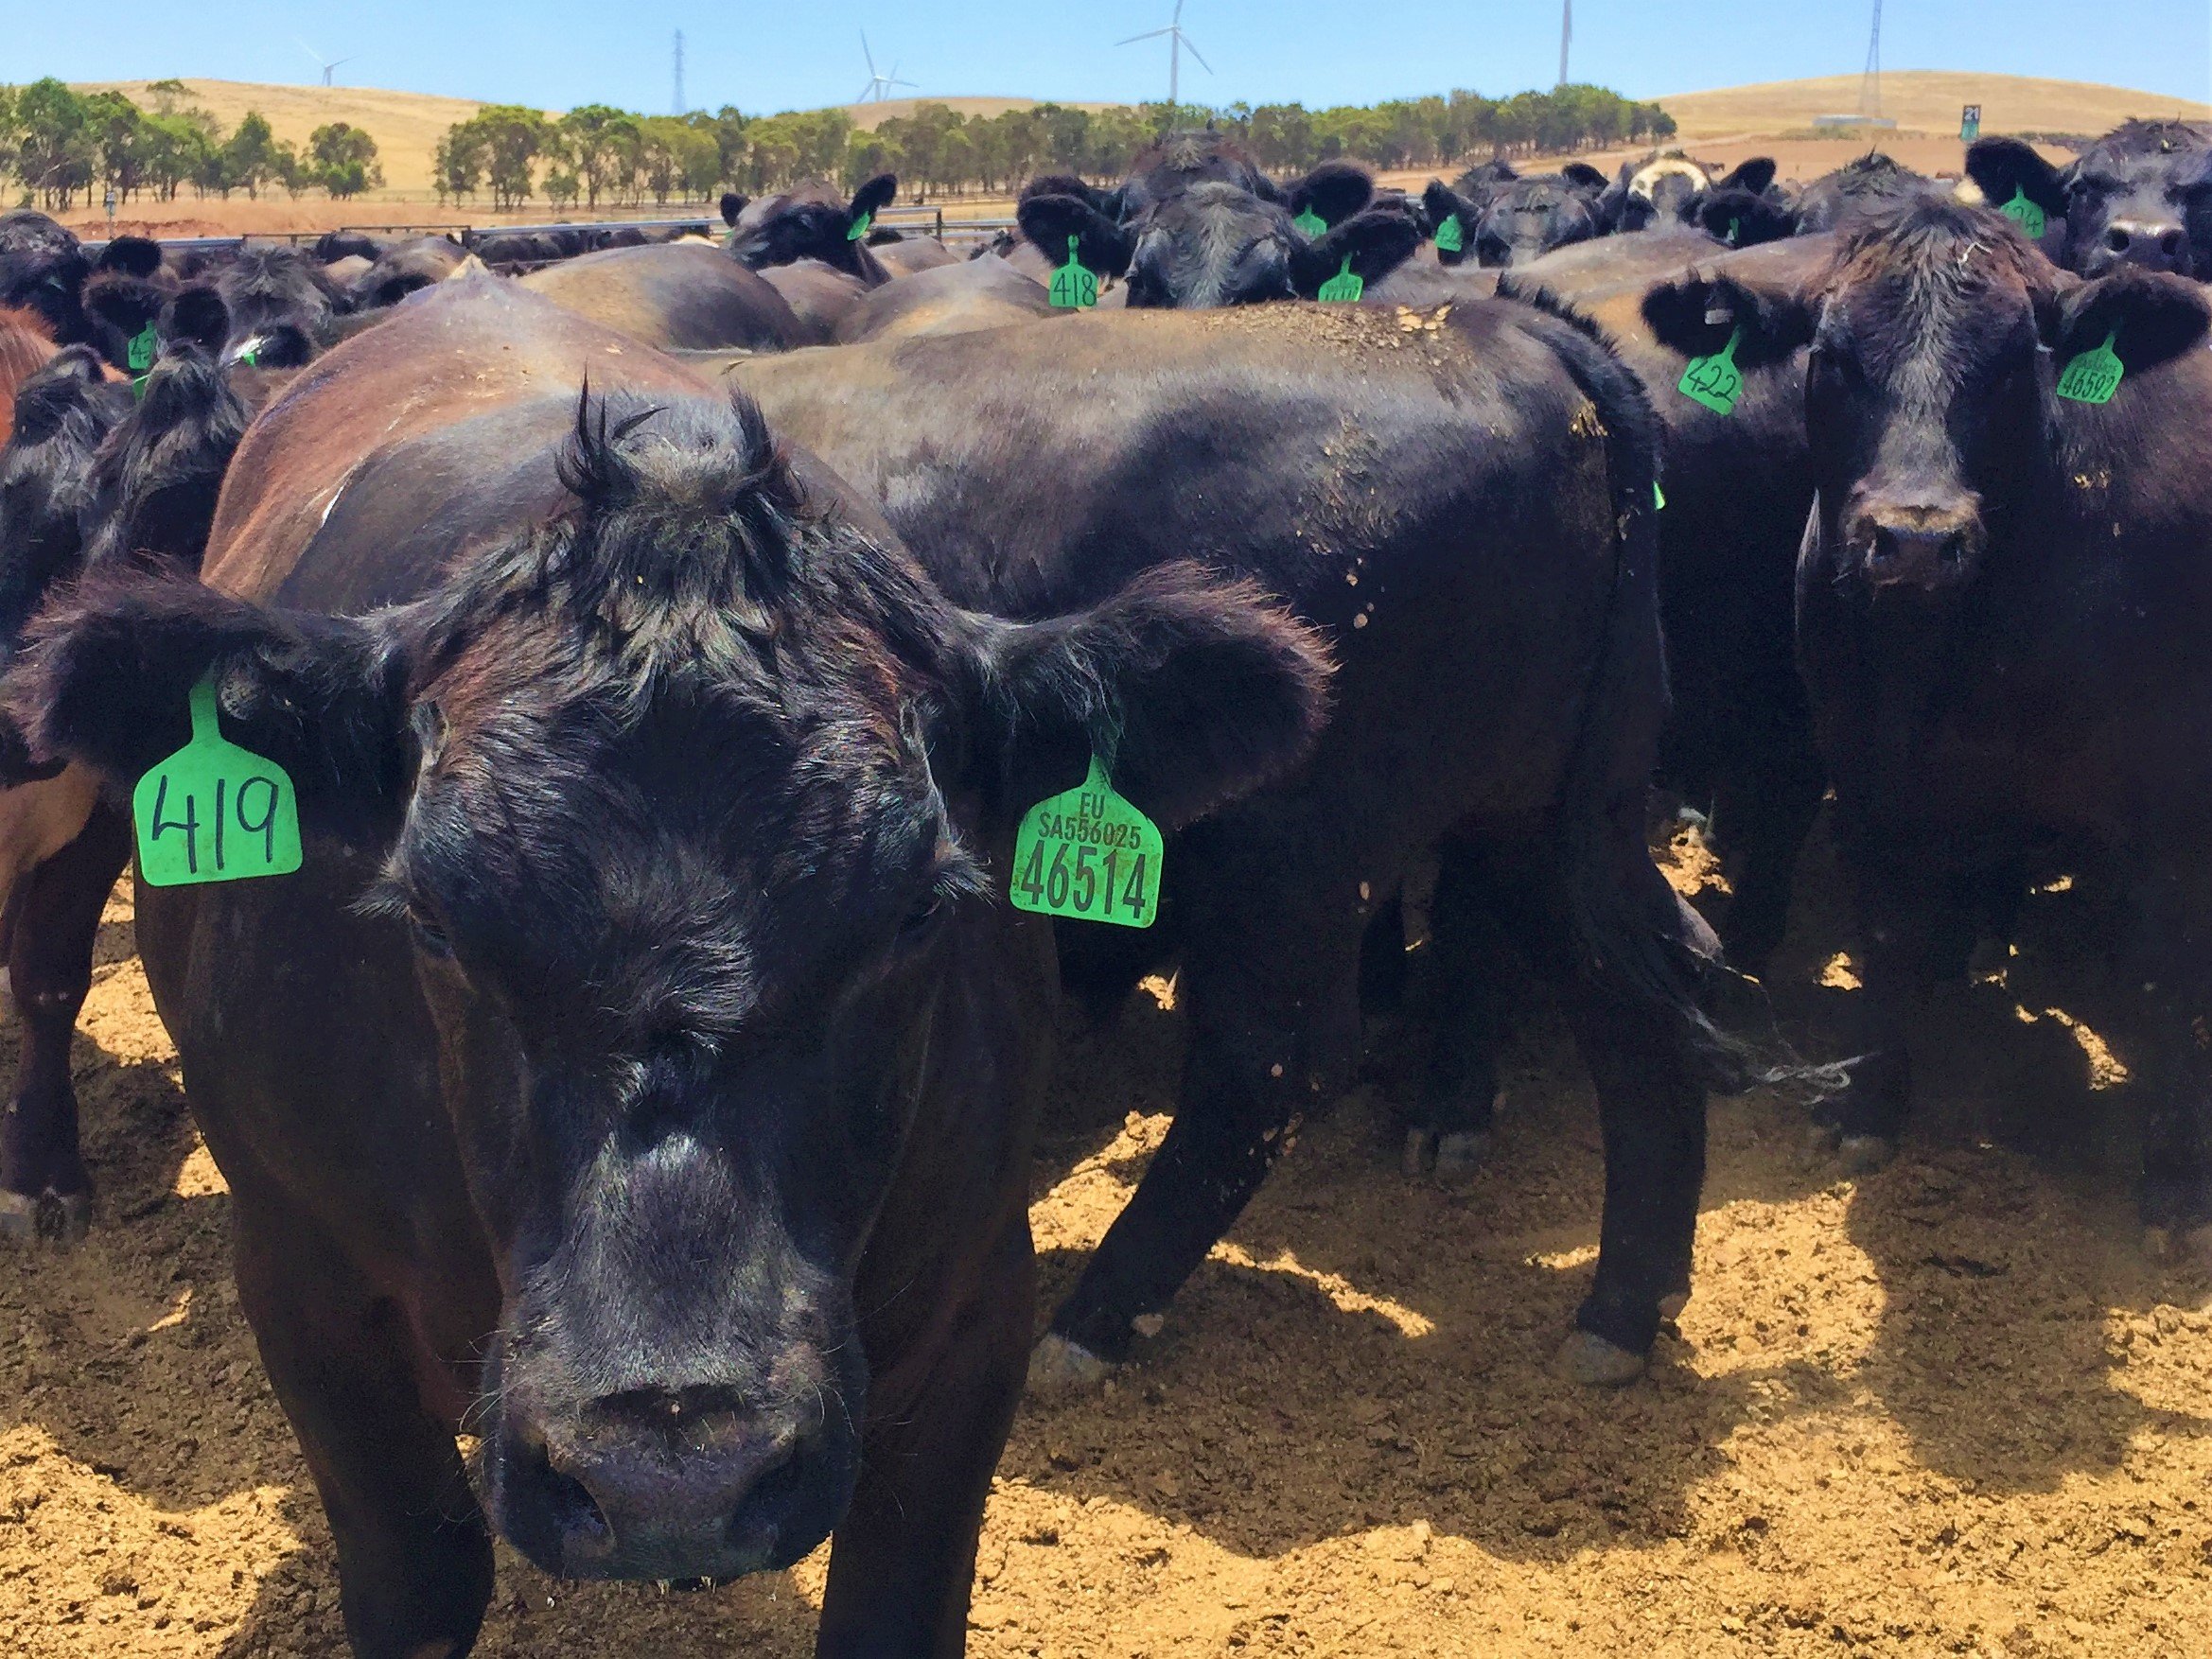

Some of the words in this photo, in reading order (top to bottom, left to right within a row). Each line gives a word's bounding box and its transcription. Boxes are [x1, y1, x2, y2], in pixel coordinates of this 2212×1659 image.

[1053, 272, 1097, 306] 418
[1687, 358, 1737, 403] 422
[2063, 368, 2115, 400] 46592
[151, 775, 279, 874] 419
[1080, 792, 1106, 820] EU
[1038, 812, 1142, 849] SA556025
[1021, 839, 1147, 919] 46514
